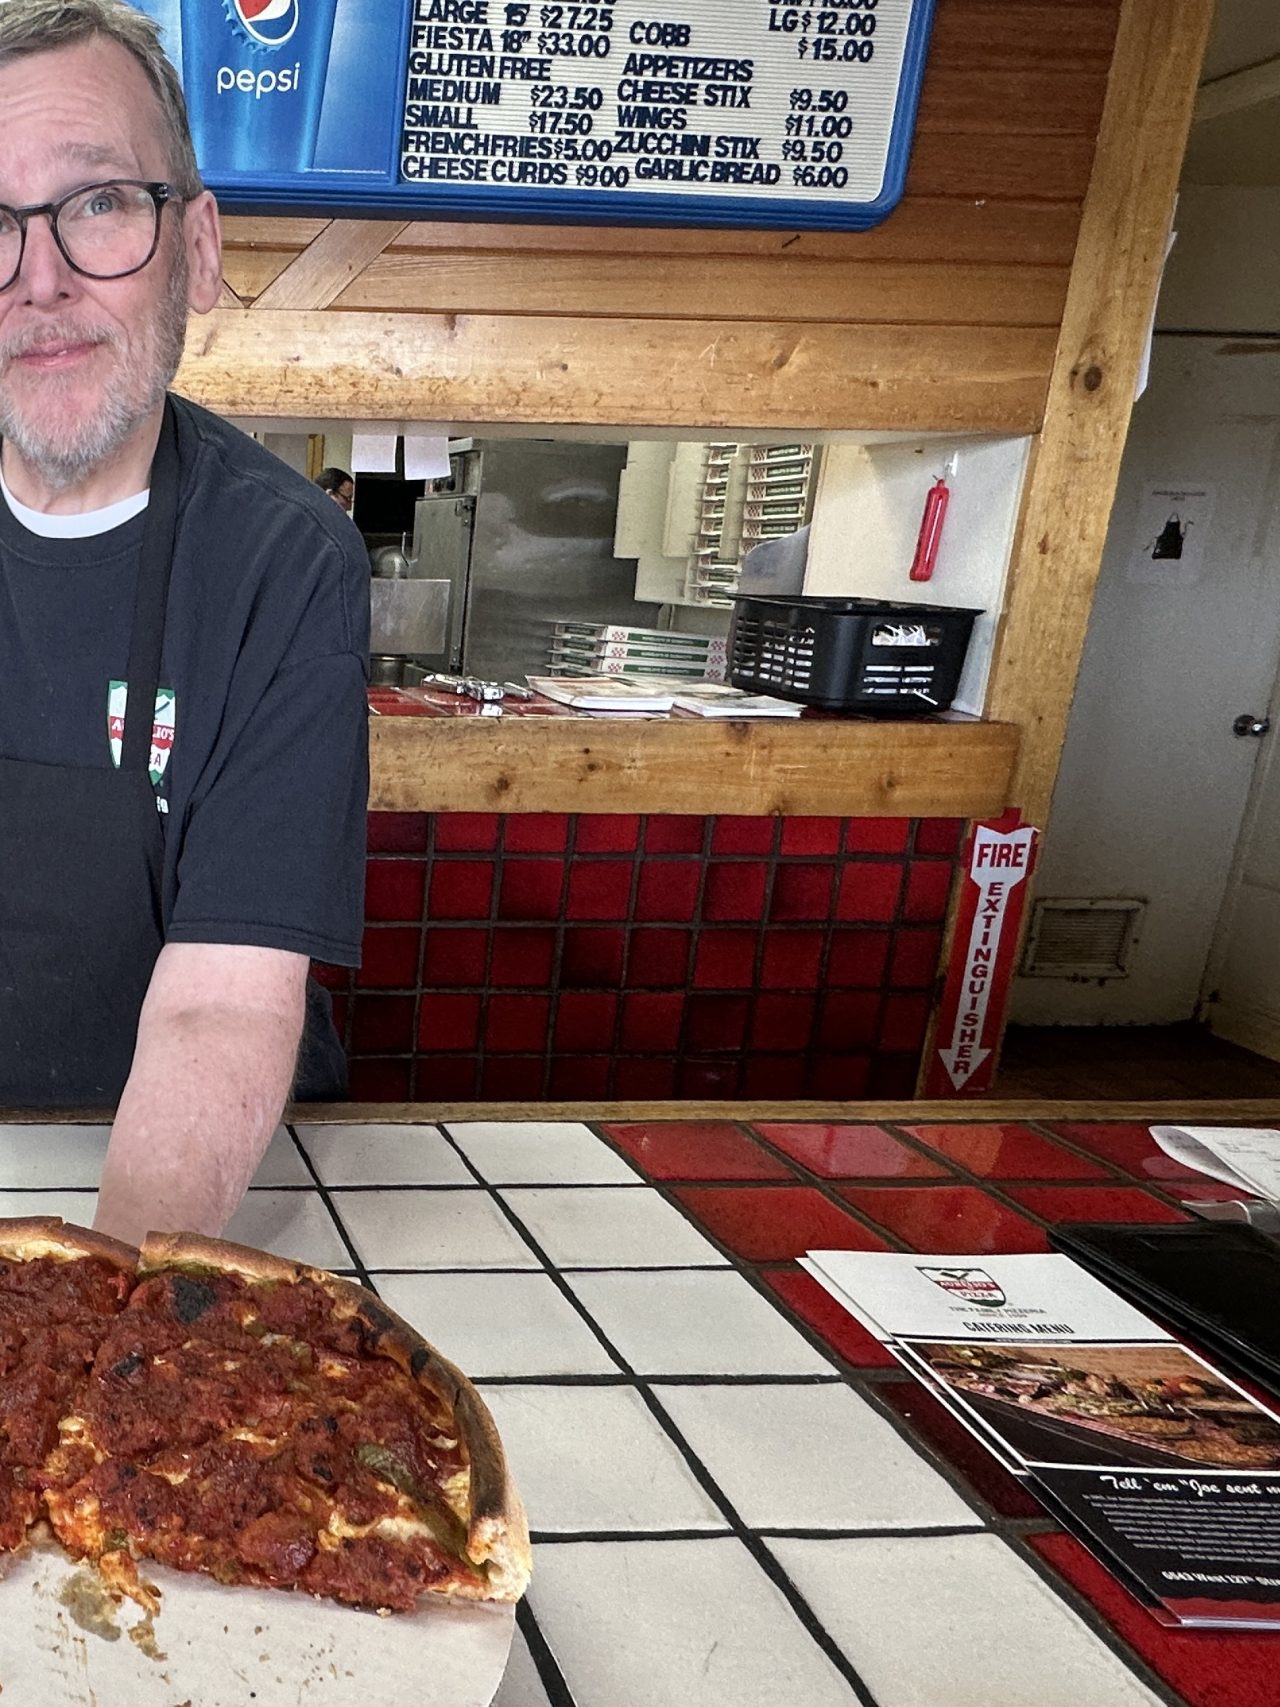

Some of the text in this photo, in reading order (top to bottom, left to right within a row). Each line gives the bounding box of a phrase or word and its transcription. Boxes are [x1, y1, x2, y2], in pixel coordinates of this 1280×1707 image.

[414, 0, 489, 24] LARGE
[768, 8, 798, 32] LG
[412, 24, 494, 52] FIESTA
[537, 31, 610, 58] $33.00
[629, 21, 691, 47] COBB
[798, 37, 874, 62] $15.00
[217, 62, 301, 99] pepsi
[408, 51, 553, 81] GLUTEN FREE
[622, 53, 754, 82] APPETIZERS
[408, 78, 604, 110] MEDIUM $23.50
[617, 79, 849, 113] CHEESE STIX $9.50
[405, 104, 594, 136] SMALL $17.50
[617, 105, 853, 139] WINGS $11.00
[403, 130, 613, 162] FRENCH FRIES $5.00
[613, 131, 844, 163] ZUCCHINI STIX $9.50
[402, 155, 489, 182] CHEESE
[491, 160, 569, 185] CURDS
[634, 157, 849, 188] GARLIC BREAD $6.00
[976, 843, 1027, 868] FIRE
[951, 882, 1005, 1075] EXTINGUISHER
[963, 1321, 1075, 1335] CATERING MENU
[1099, 1475, 1143, 1491] Tell
[1225, 1482, 1263, 1495] sent
